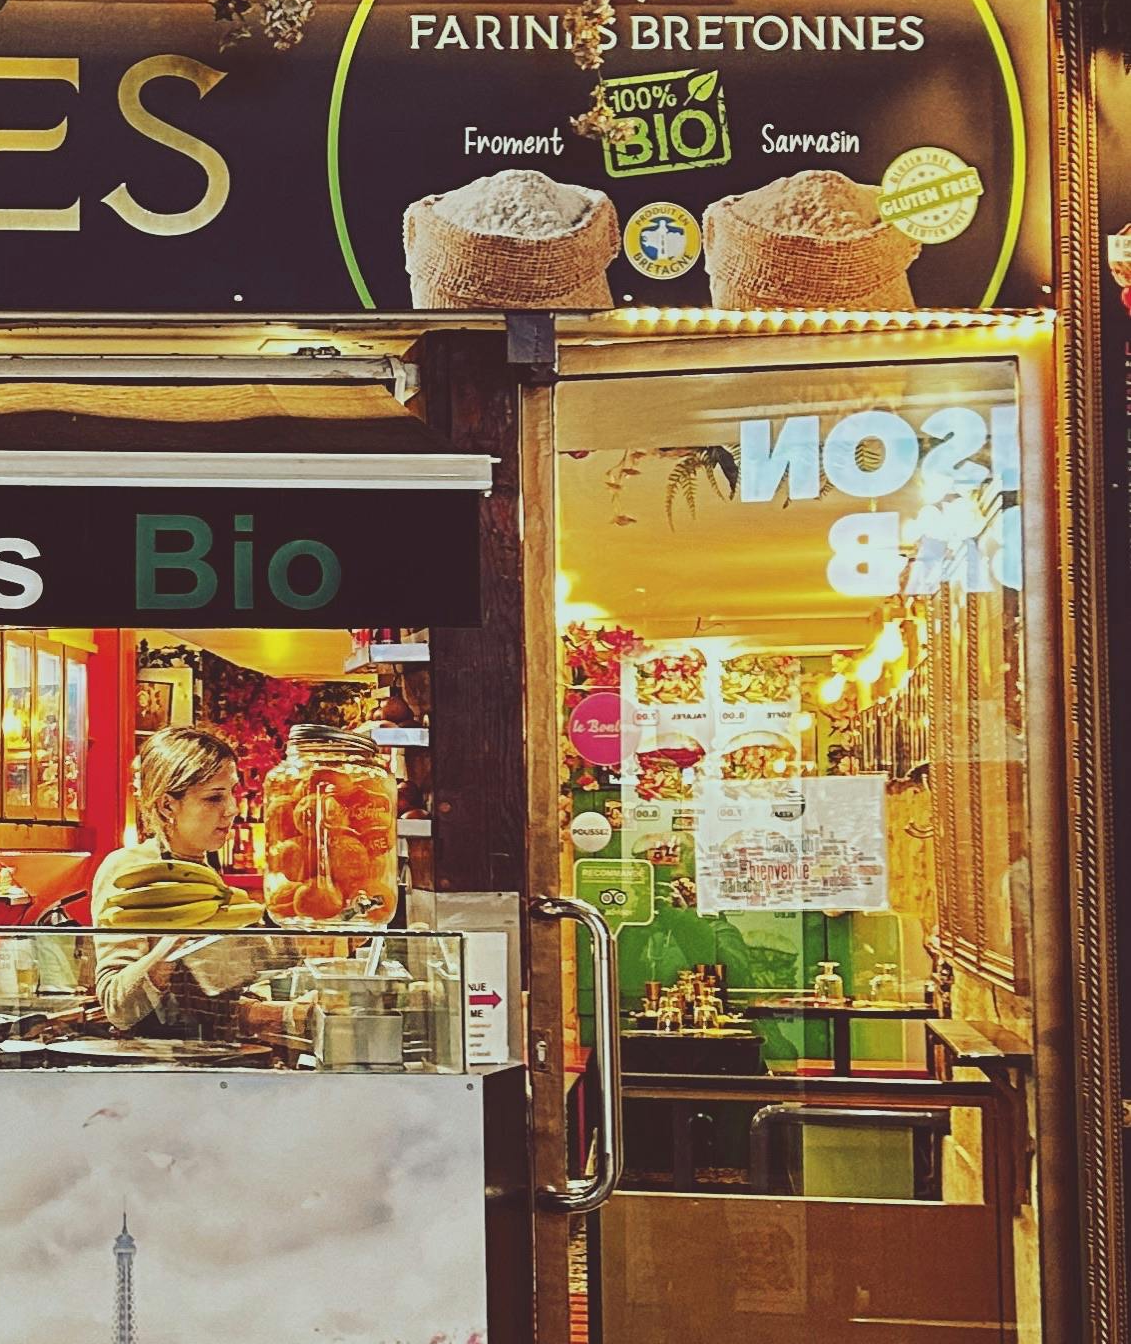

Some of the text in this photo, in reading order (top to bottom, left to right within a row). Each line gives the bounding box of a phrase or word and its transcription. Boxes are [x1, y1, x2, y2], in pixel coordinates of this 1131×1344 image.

[409, 14, 925, 51] FARINS BRETONNES
[609, 83, 677, 113] 100%
[464, 123, 860, 156] Froment Sarrasin
[616, 109, 717, 166] BIO
[881, 174, 979, 216] GLUTEN FREE
[635, 206, 677, 227] PRODUIT
[633, 251, 694, 276] BRETAGNE
[135, 513, 342, 612] Bio
[572, 828, 610, 836] POUSSEZ
